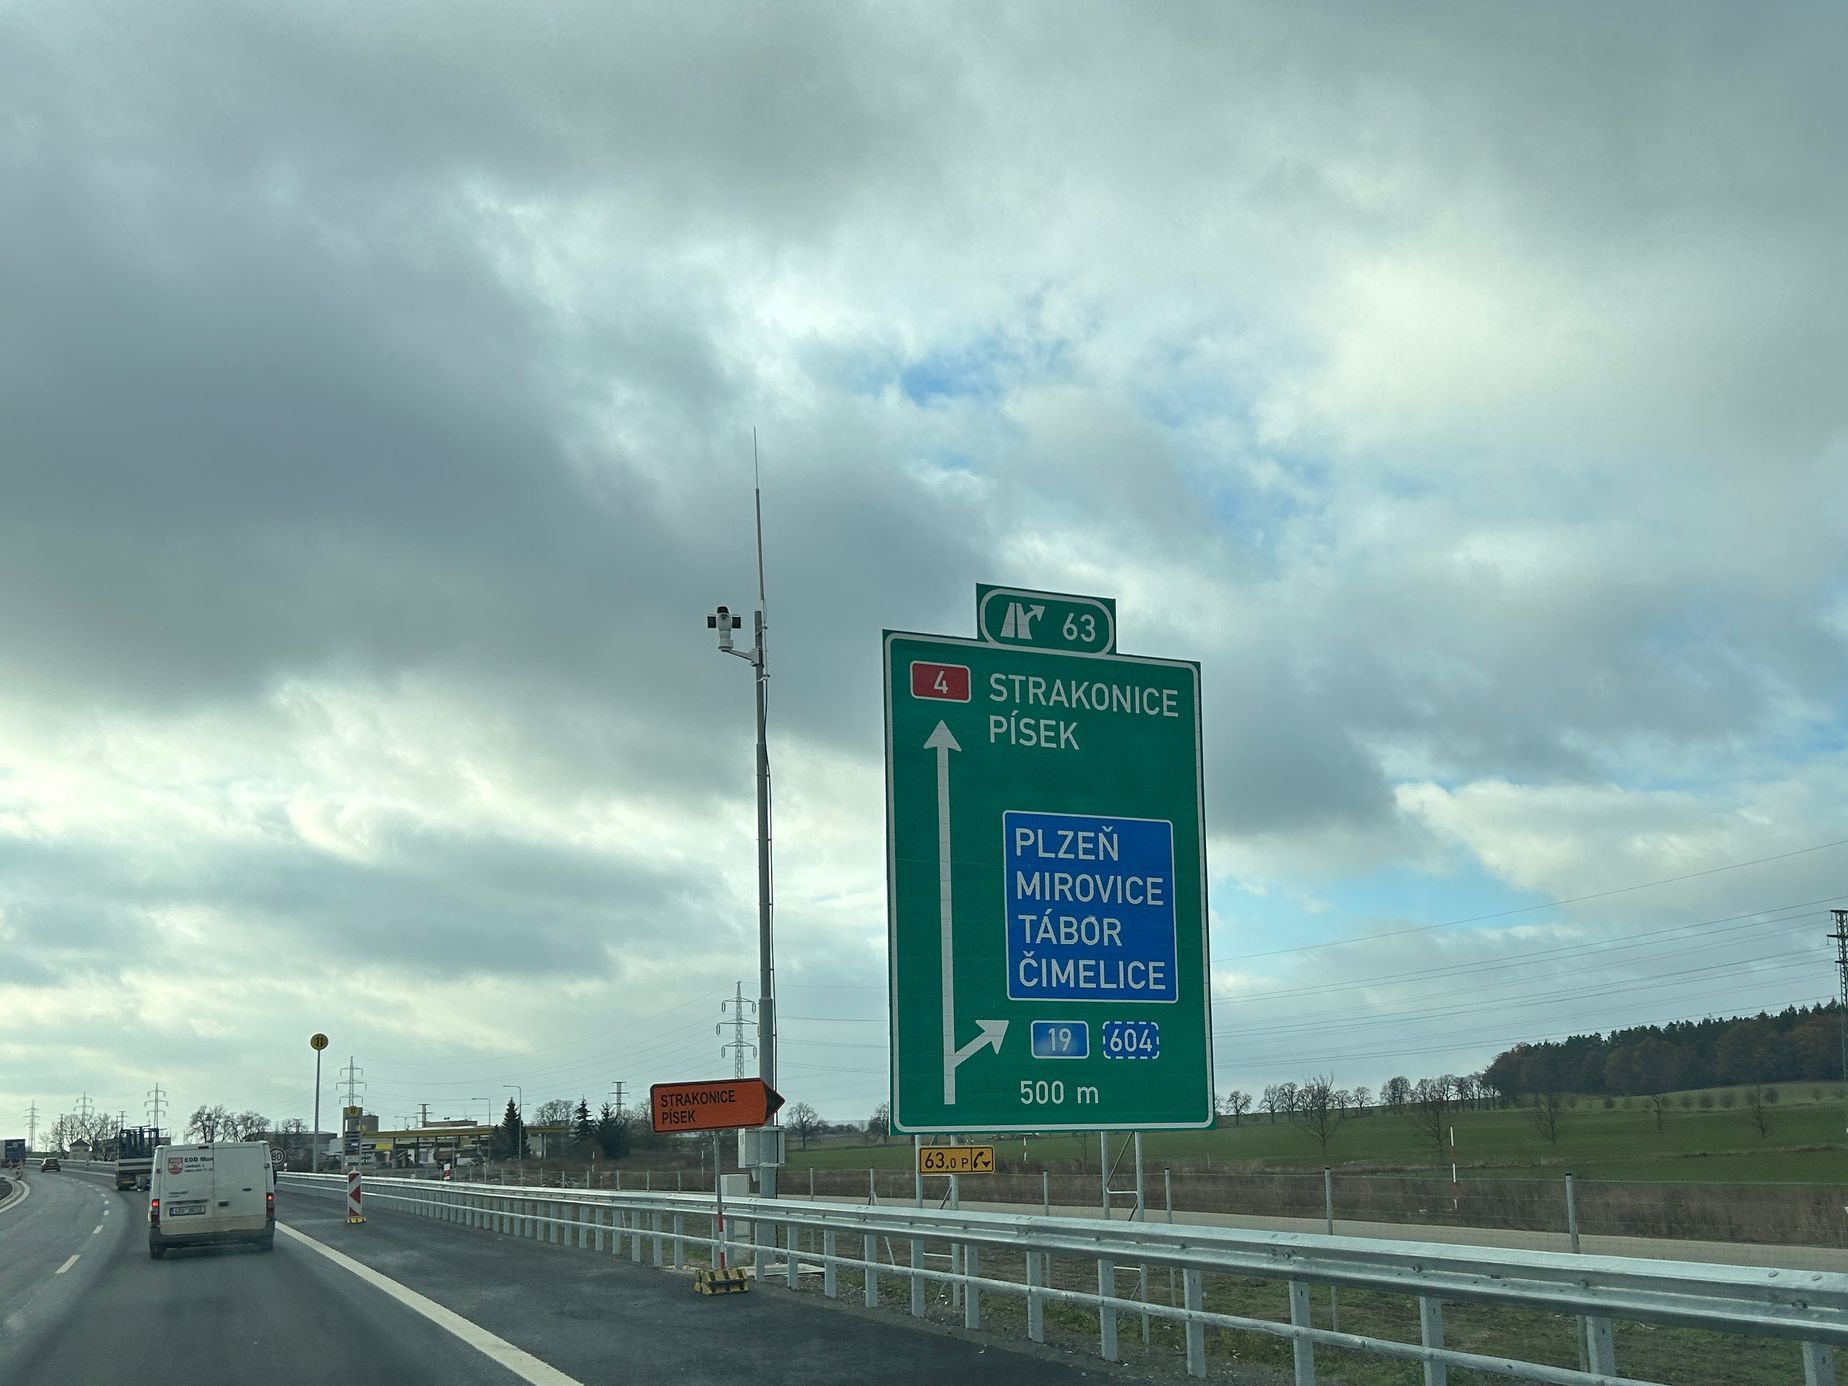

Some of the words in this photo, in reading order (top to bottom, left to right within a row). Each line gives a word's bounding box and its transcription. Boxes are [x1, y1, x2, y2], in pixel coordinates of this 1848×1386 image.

[1062, 612, 1096, 642] 63
[933, 670, 949, 694] 4
[989, 673, 1179, 717] STRAKONICE
[989, 710, 1080, 750] PÍSEK
[1015, 826, 1119, 861] PLZEŇ
[1016, 871, 1164, 905] MIROVICE
[1018, 908, 1122, 946] TÁBOR
[1019, 950, 1166, 990] ČIMELICE
[1048, 1028, 1072, 1052] 19
[1109, 1028, 1153, 1052] 604
[660, 1090, 736, 1107] STRAKONICE
[1020, 1080, 1064, 1104] 500
[1077, 1086, 1099, 1104] m
[662, 1108, 696, 1125] PÍSEK
[961, 1157, 969, 1168] P
